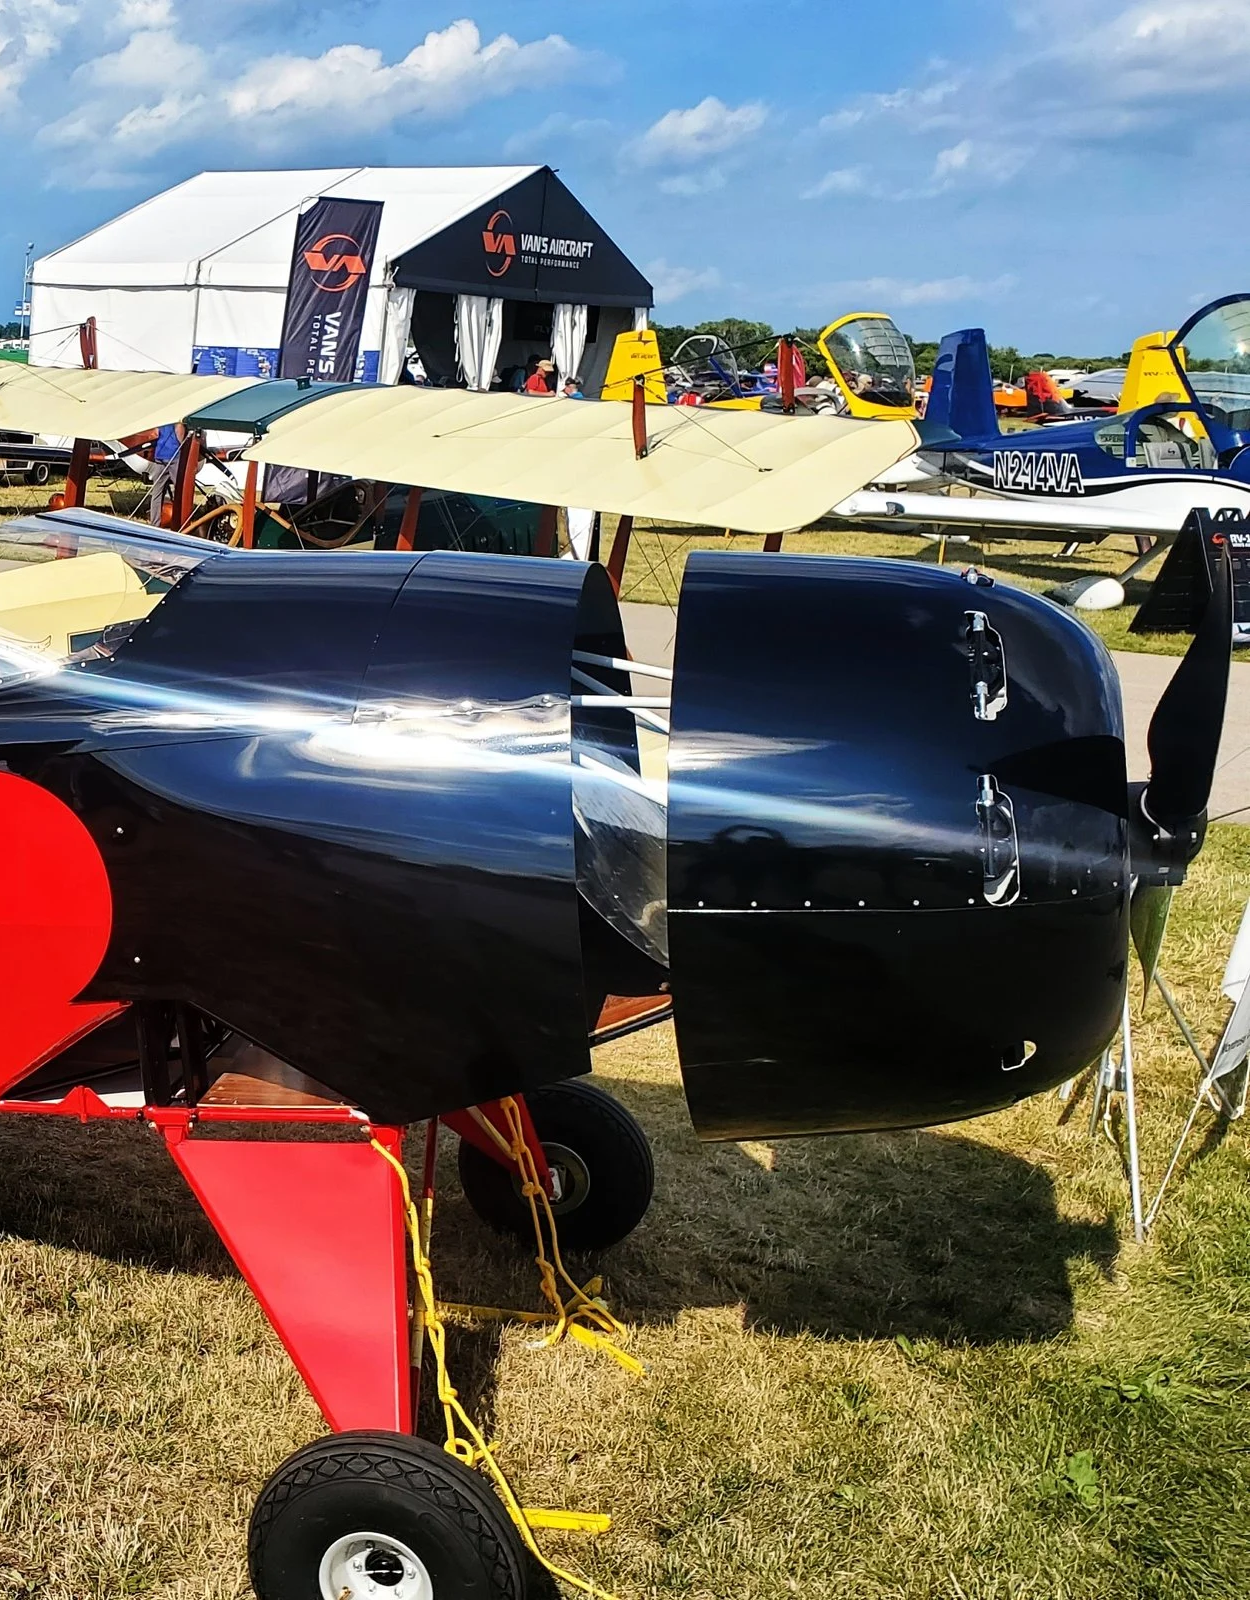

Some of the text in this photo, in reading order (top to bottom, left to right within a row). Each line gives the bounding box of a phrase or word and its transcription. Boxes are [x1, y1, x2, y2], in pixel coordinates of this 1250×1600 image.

[520, 233, 594, 259] VAN'S AIRCRAFT
[521, 255, 580, 269] TOTAL PERFORMANCE
[309, 314, 322, 352] TOTAL
[318, 311, 342, 374] VAN'S
[993, 450, 1086, 495] N214VA
